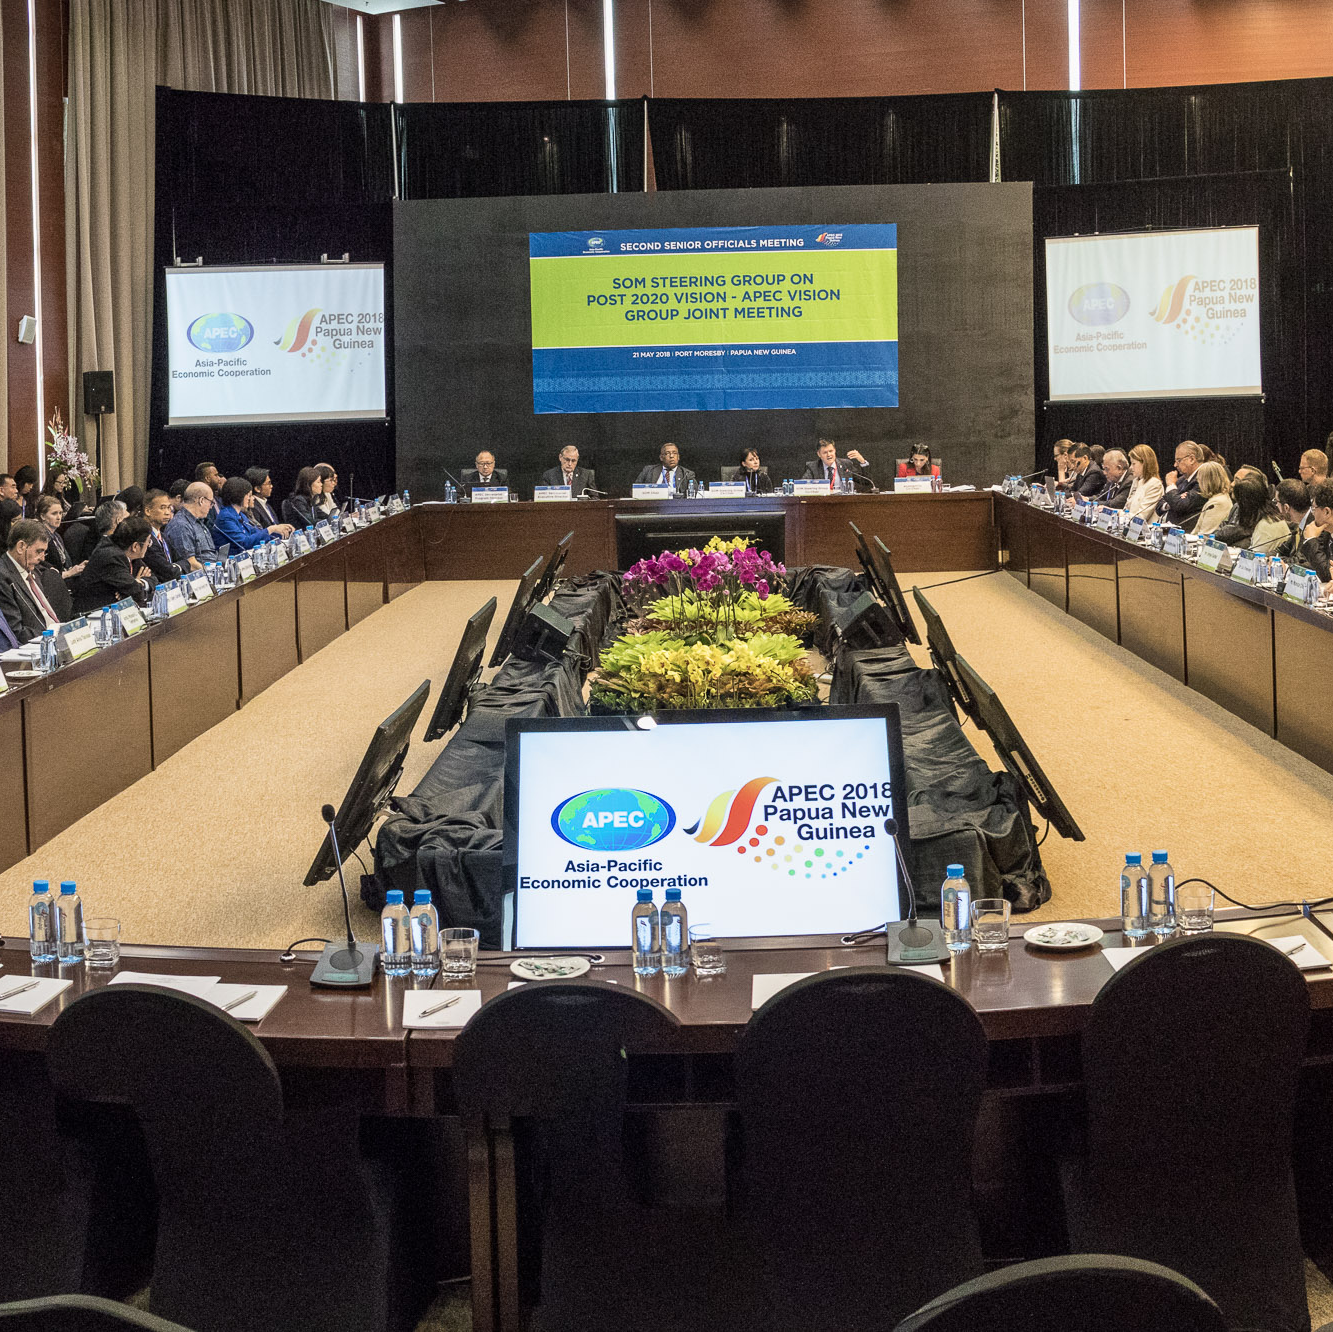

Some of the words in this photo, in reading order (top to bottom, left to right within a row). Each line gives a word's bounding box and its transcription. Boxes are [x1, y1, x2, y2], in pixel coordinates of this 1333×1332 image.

[620, 242, 661, 251] SECOND
[664, 241, 701, 250] SENIOR
[704, 240, 756, 249] OFFICIALS
[759, 238, 804, 247] MEETING
[612, 277, 646, 289] SOM
[650, 275, 726, 289] STEERING
[731, 274, 786, 287] GROUP
[790, 273, 814, 285] ON
[1193, 279, 1226, 293] APEC
[1229, 277, 1257, 291] 2018
[587, 293, 627, 306] POST
[631, 292, 669, 305] 2020
[673, 291, 727, 304] VISION
[741, 290, 783, 302] APEC
[787, 289, 840, 301] VISION
[1083, 298, 1115, 310] APEC
[1189, 294, 1225, 308] Papua
[1228, 292, 1255, 304] New
[319, 313, 354, 325] APEC
[357, 312, 384, 324] 2018
[624, 308, 679, 321] GROUP
[683, 307, 729, 320] JOINT
[734, 306, 803, 319] MEETING
[1206, 307, 1247, 320] Guinea
[203, 326, 238, 339] APEC
[315, 326, 352, 339] Papua
[356, 325, 382, 336] New
[1075, 331, 1124, 342] Asia-Pacific
[332, 338, 374, 349] Guinea
[1053, 344, 1095, 354] Economic
[1096, 341, 1148, 352] Cooperation
[194, 358, 248, 368] Asia-Pacific
[171, 369, 215, 379] Economic
[217, 368, 272, 377] Cooperation
[771, 784, 835, 803] APEC
[842, 782, 892, 801] 2018
[581, 810, 645, 829] APEC
[763, 804, 834, 825] Papua
[841, 801, 890, 819] New
[797, 823, 876, 841] Guinea
[564, 858, 663, 873] Asia-Pacific
[519, 876, 602, 890] Economic
[606, 874, 709, 889] Cooperation
